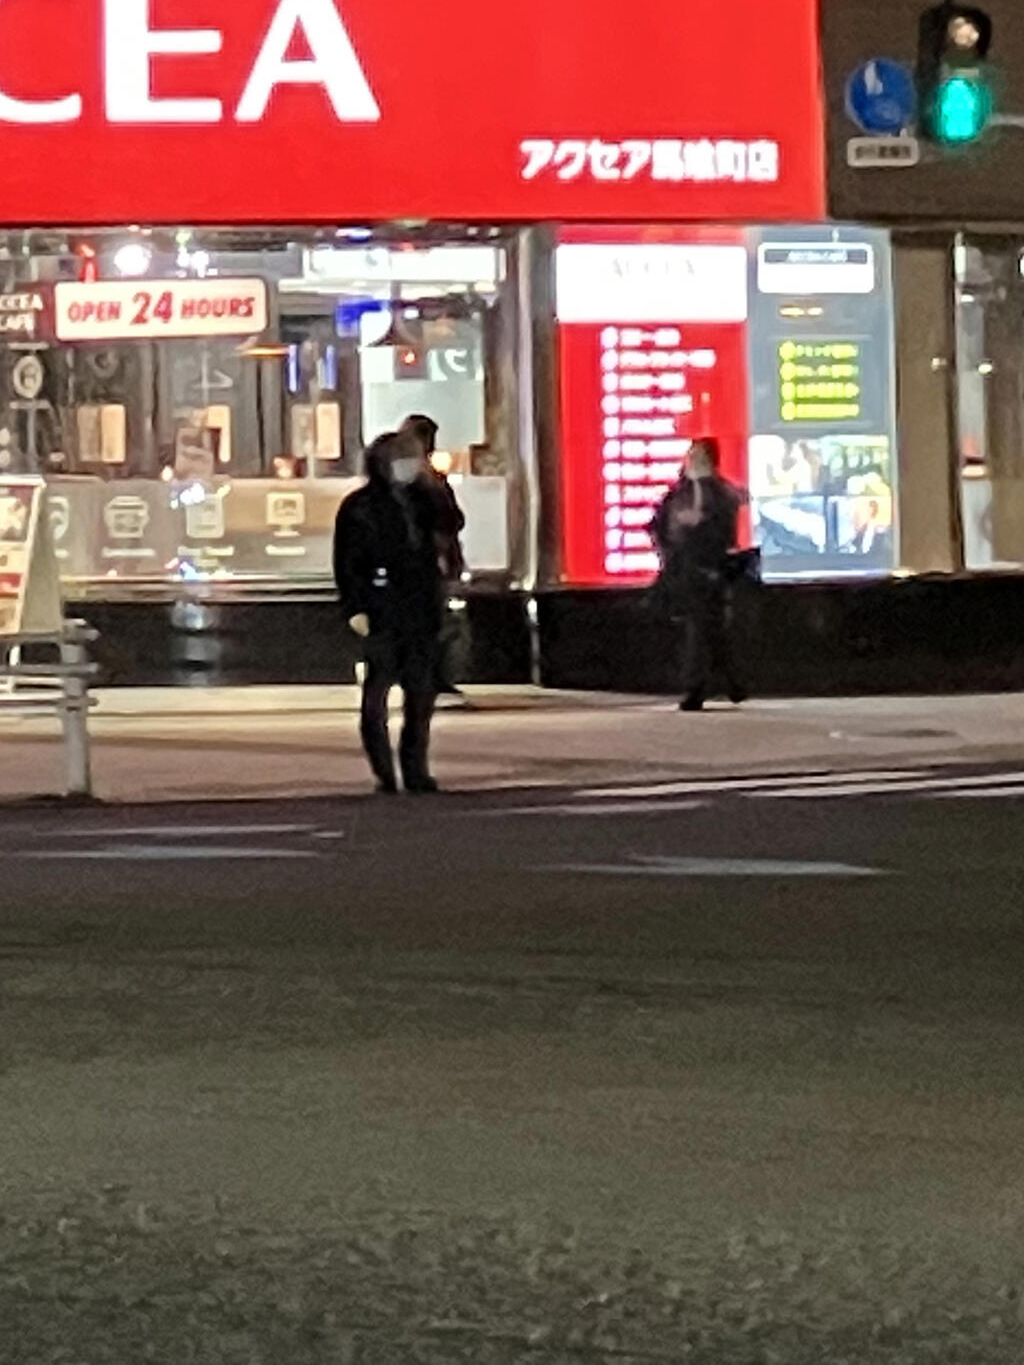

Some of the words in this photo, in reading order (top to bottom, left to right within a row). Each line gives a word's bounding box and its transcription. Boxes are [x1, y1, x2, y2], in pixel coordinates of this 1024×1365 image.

[67, 300, 122, 322] OPEN
[130, 290, 173, 325] 24
[180, 296, 254, 319] HOURS
